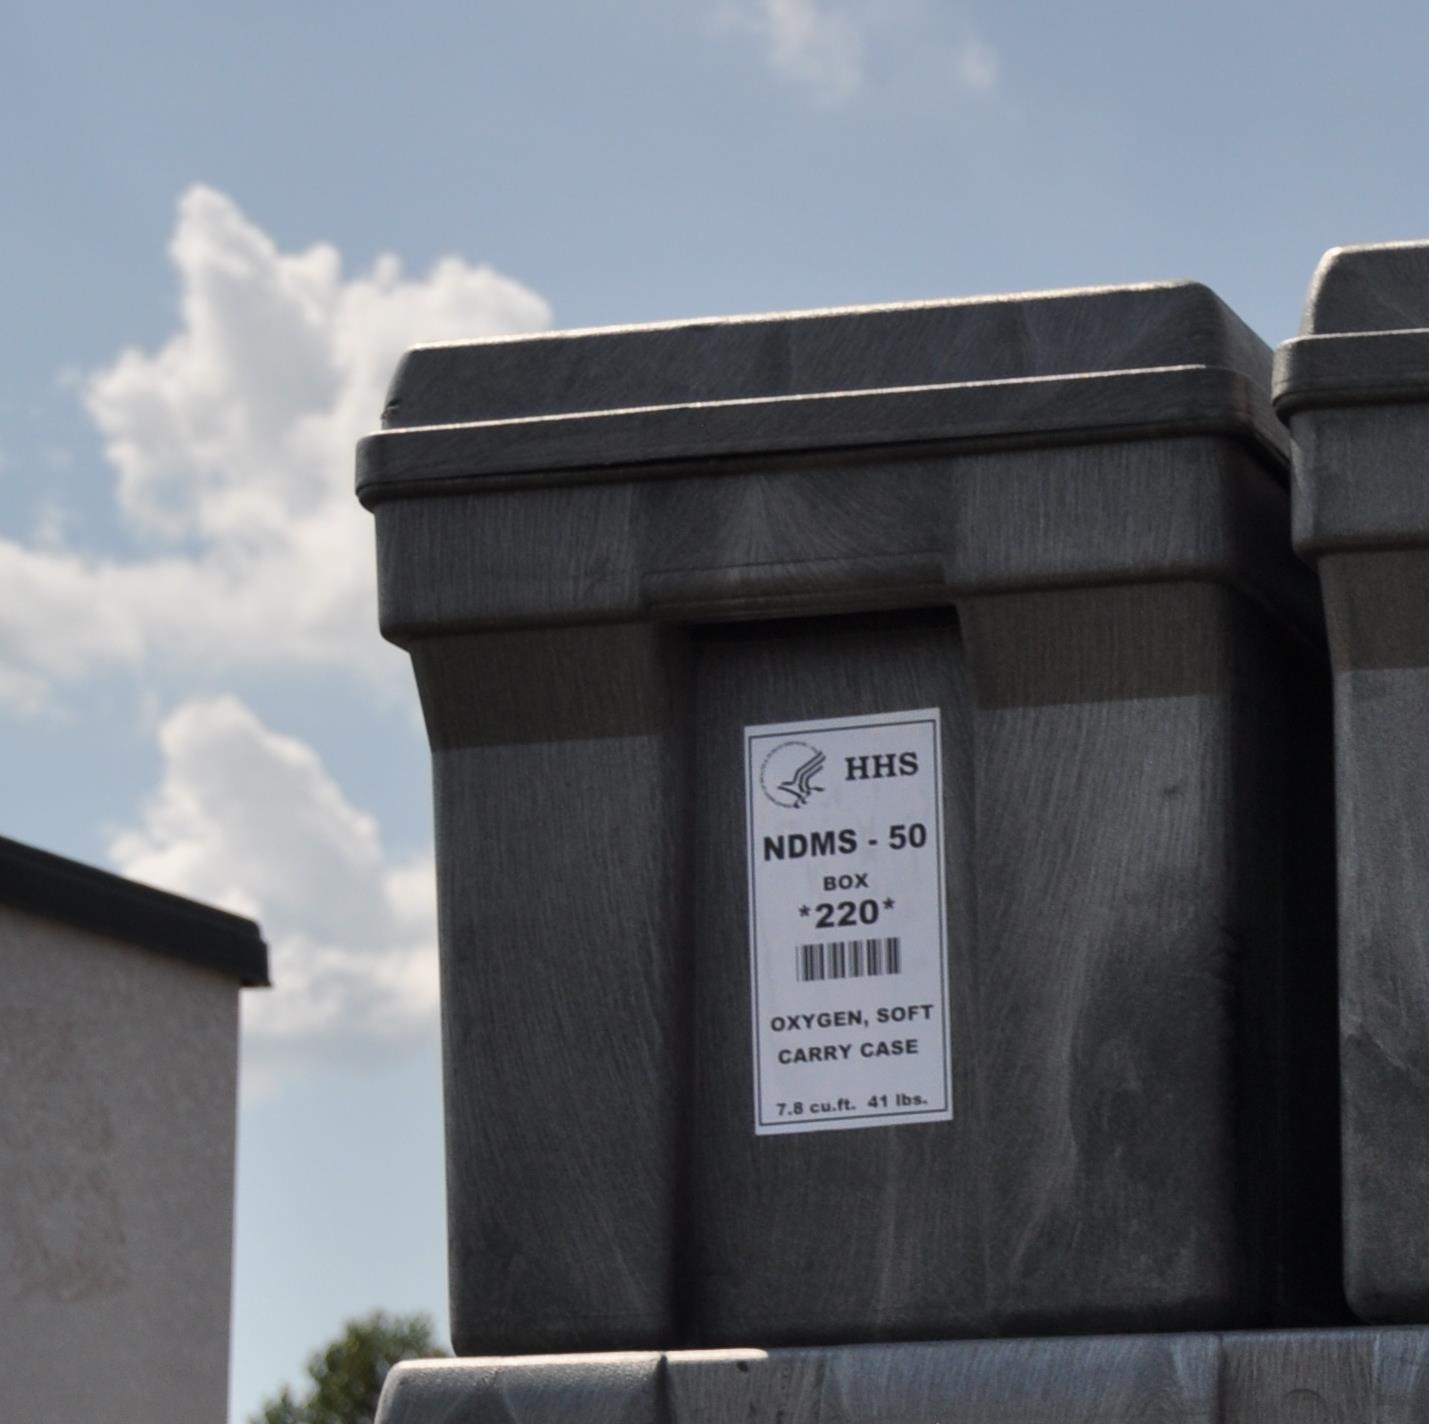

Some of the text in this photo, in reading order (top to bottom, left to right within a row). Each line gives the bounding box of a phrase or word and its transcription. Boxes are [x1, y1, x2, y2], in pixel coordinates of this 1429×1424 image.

[844, 751, 919, 781] HHS
[763, 828, 858, 862] NDMS
[889, 822, 927, 851] 50
[823, 872, 869, 892] BOX
[770, 1003, 934, 1032] OXYGEN, SOFT
[777, 1038, 919, 1065] CARRY CASE
[776, 1093, 928, 1116] 7.8 cu.ft. 41 lbs.
